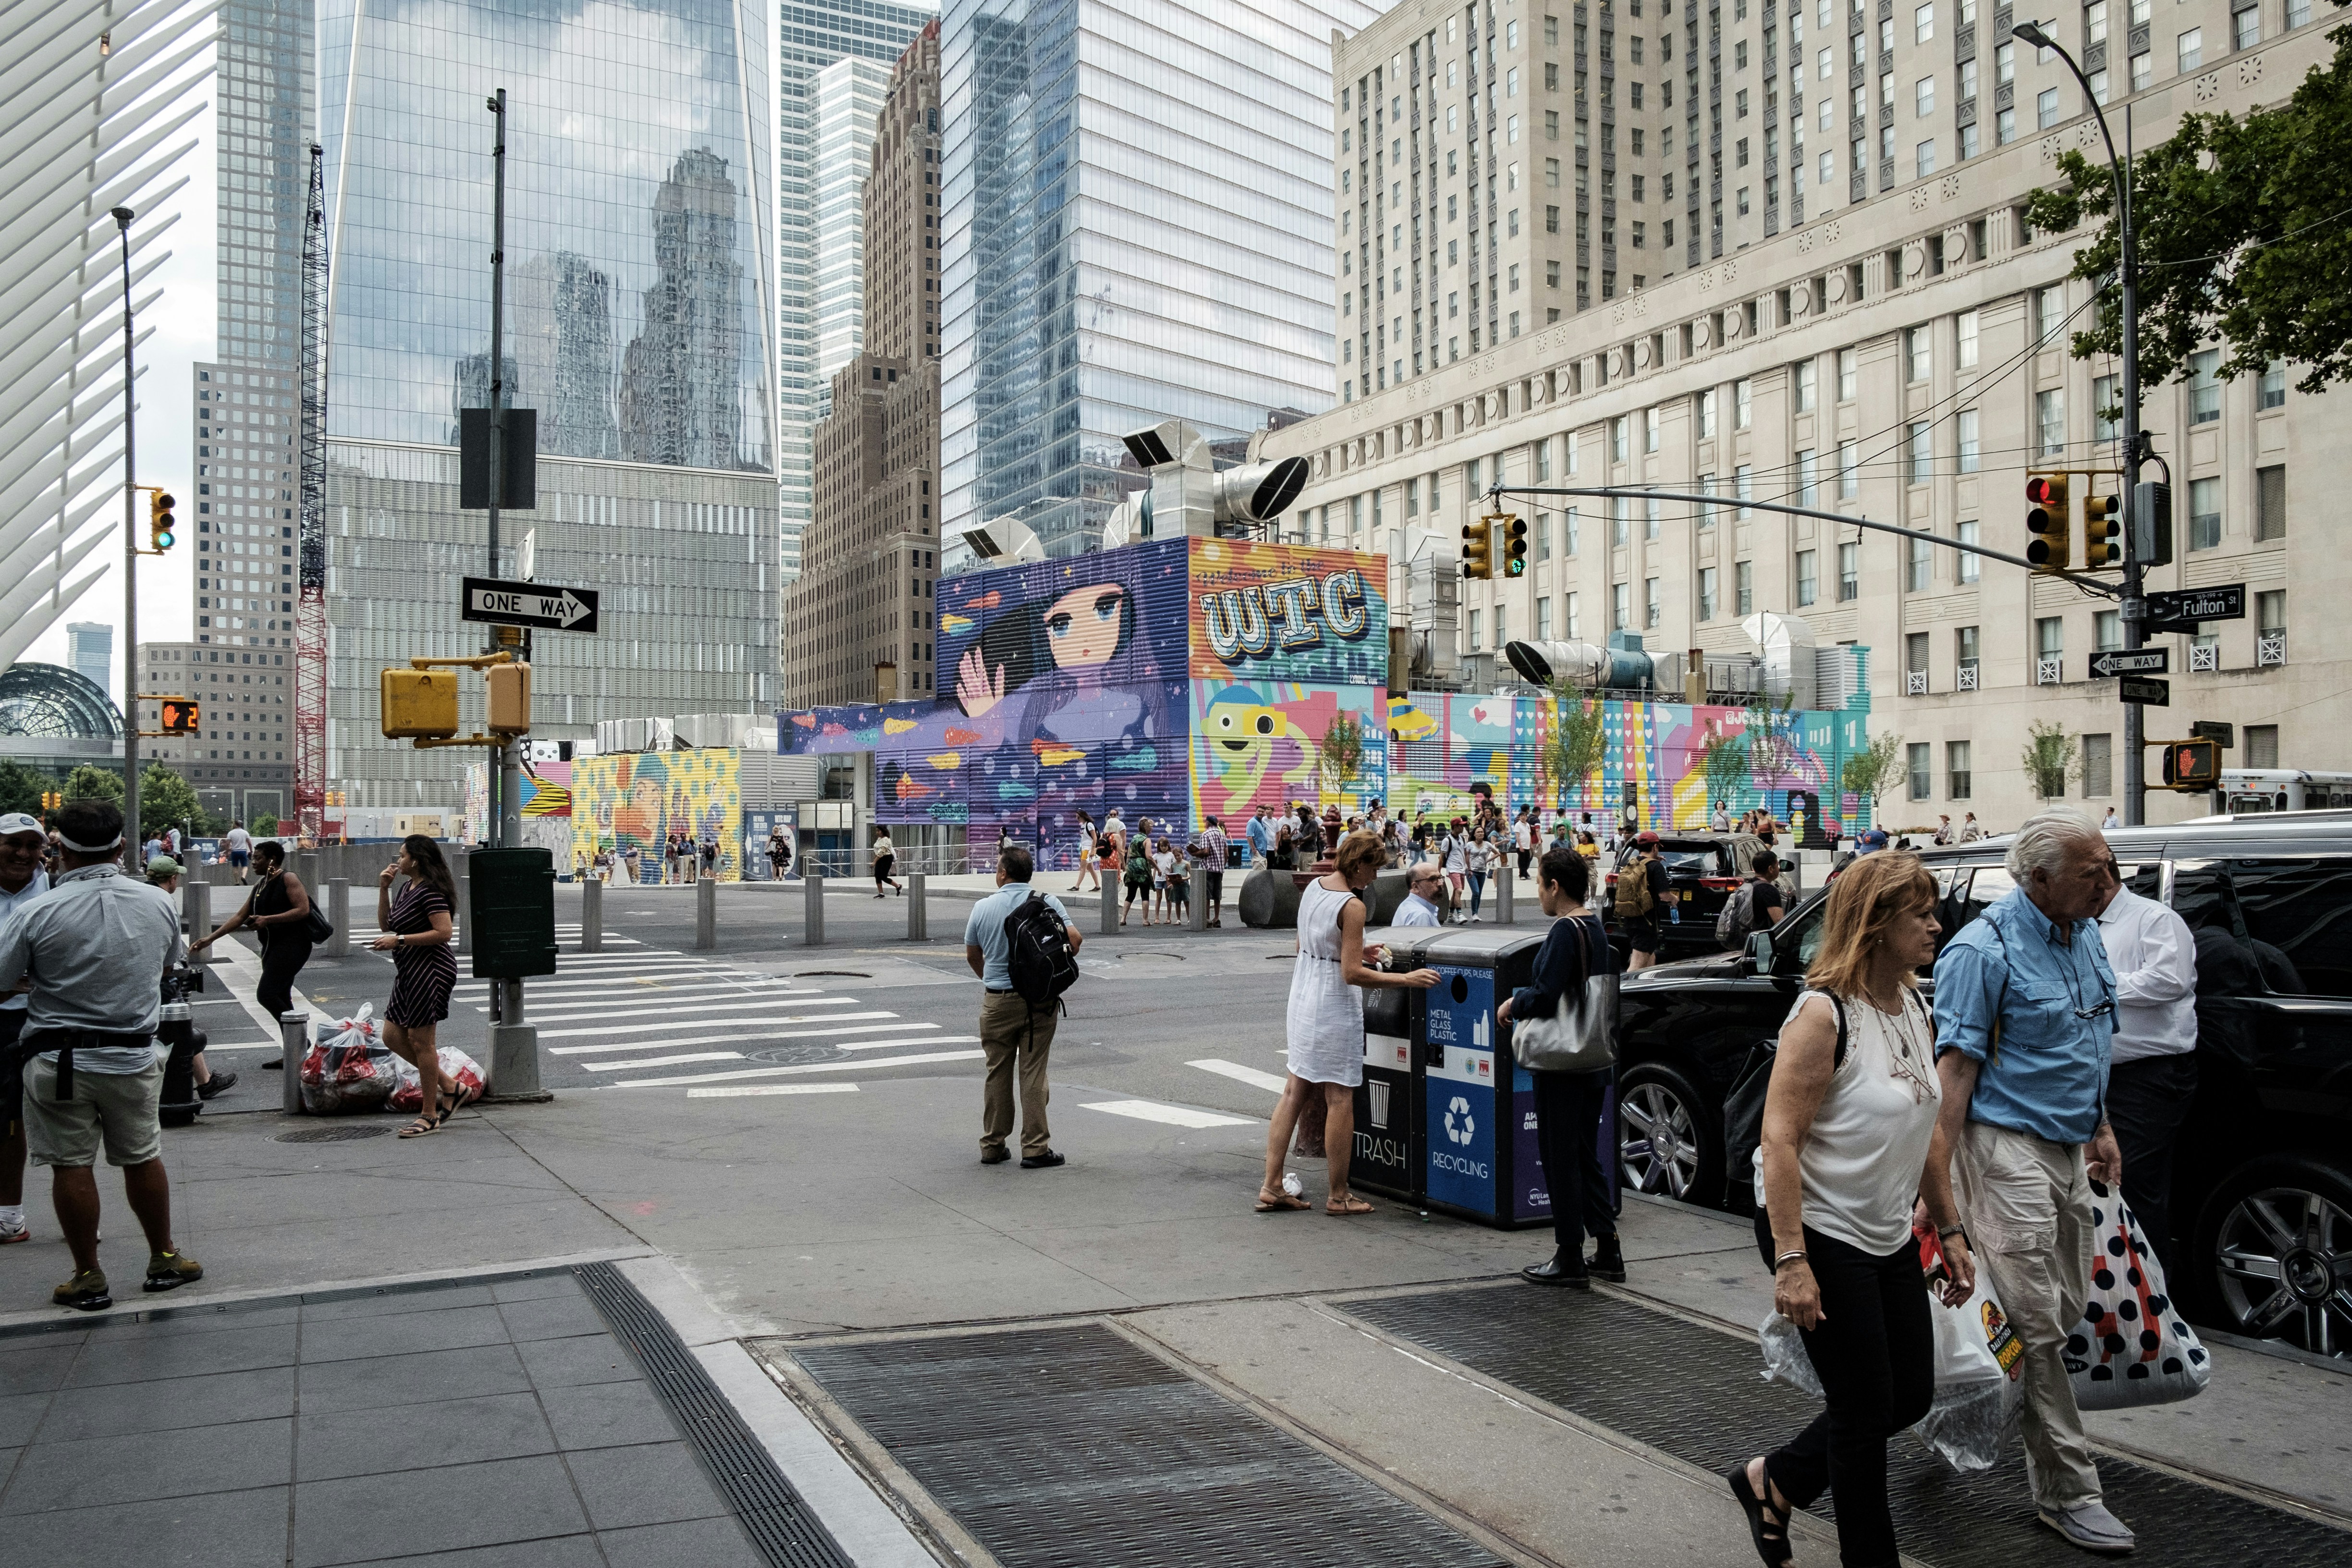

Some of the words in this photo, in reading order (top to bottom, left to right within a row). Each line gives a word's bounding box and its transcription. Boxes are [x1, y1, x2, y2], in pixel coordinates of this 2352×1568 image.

[1281, 561, 1296, 576] to
[483, 593, 521, 612] ONE
[540, 599, 578, 618] WAY
[2183, 600, 2225, 616] Fulton
[2229, 596, 2236, 604] St
[1199, 569, 1367, 662] WTC
[2101, 659, 2122, 670] ONE
[2134, 656, 2158, 667] WAY
[2127, 685, 2142, 696] ONE
[2147, 686, 2162, 697] WAY
[188, 707, 197, 727] 2
[1436, 967, 1457, 975] COFFEE
[1473, 970, 1493, 980] PLEASE
[1430, 1009, 1452, 1020] METAL
[1430, 1019, 1451, 1030] GLASS
[1430, 1029, 1457, 1041] PLASTIC
[1523, 1121, 1538, 1130] ONE
[1353, 1131, 1405, 1169] TRASH
[1433, 1152, 1488, 1178] RECYCLING
